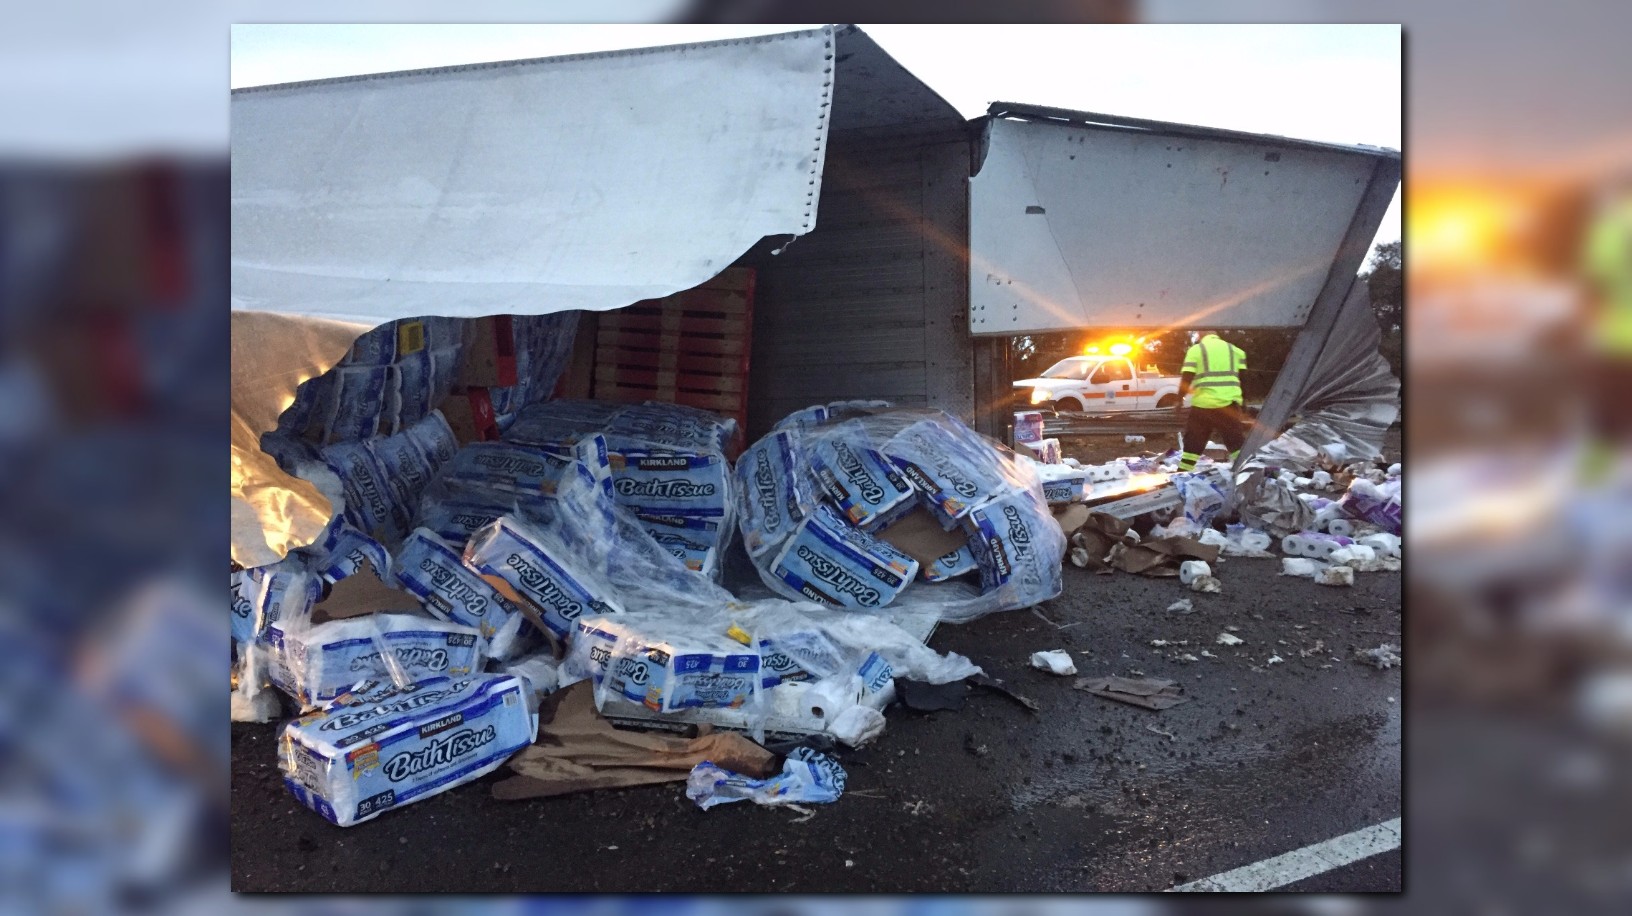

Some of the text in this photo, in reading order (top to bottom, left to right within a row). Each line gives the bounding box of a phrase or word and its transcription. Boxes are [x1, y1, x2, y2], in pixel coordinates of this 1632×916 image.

[640, 458, 687, 467] KIRKLAND
[820, 469, 846, 500] KIRKLAND
[886, 574, 898, 586] 30
[421, 714, 462, 734] KIRKLAND
[360, 794, 393, 811] 30 425
